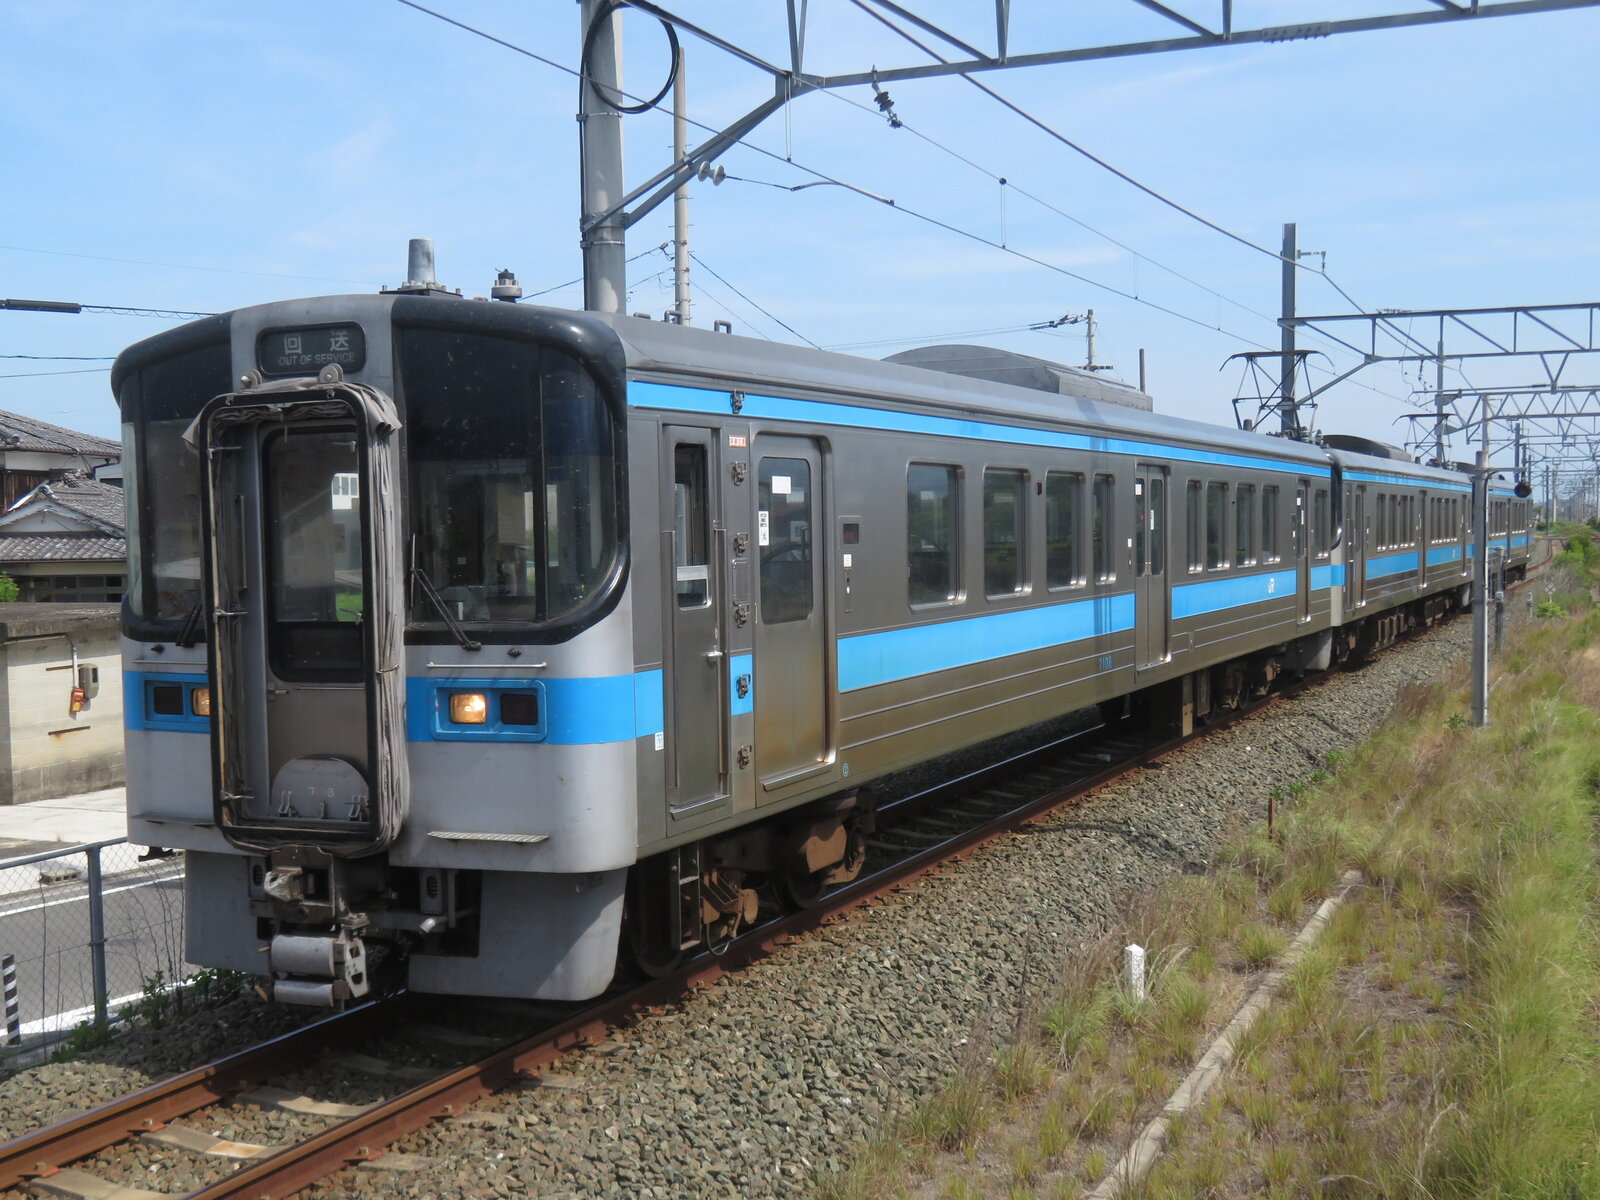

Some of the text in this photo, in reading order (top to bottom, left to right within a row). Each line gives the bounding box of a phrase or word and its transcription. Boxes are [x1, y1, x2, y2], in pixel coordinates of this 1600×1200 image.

[279, 352, 355, 366] OUT OF SERVICE
